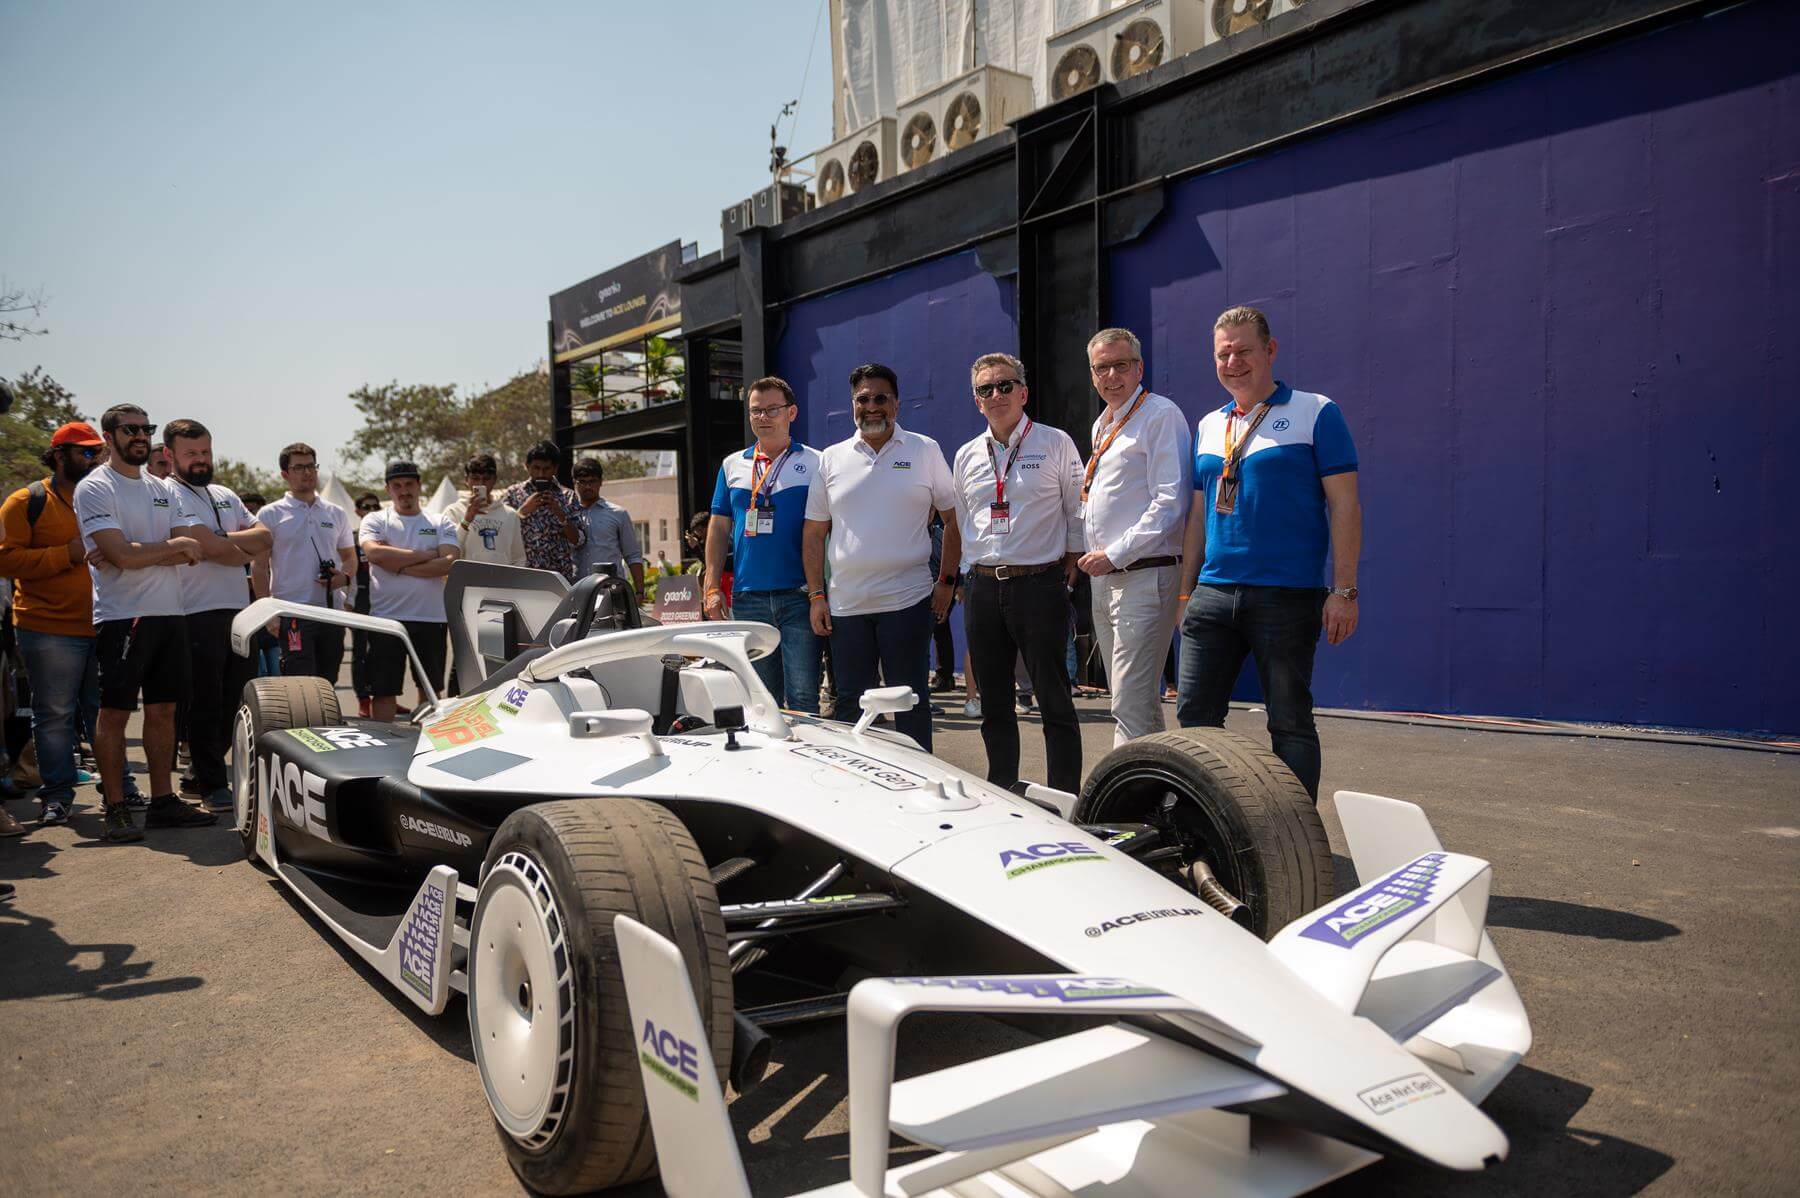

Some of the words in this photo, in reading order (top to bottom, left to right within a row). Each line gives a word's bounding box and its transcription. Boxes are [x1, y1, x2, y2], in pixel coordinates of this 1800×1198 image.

[664, 588, 692, 606] greenko
[661, 612, 674, 621] 2023
[675, 611, 700, 621] GREENKO
[504, 686, 529, 708] ACE
[312, 727, 388, 749] ACE
[874, 771, 917, 787] Gen
[270, 752, 332, 843] ACE
[1000, 842, 1097, 868] ACE
[1324, 893, 1402, 933] ACE
[404, 948, 431, 985] ACE
[643, 1019, 698, 1082] ACE
[1370, 1094, 1393, 1105] Ace
